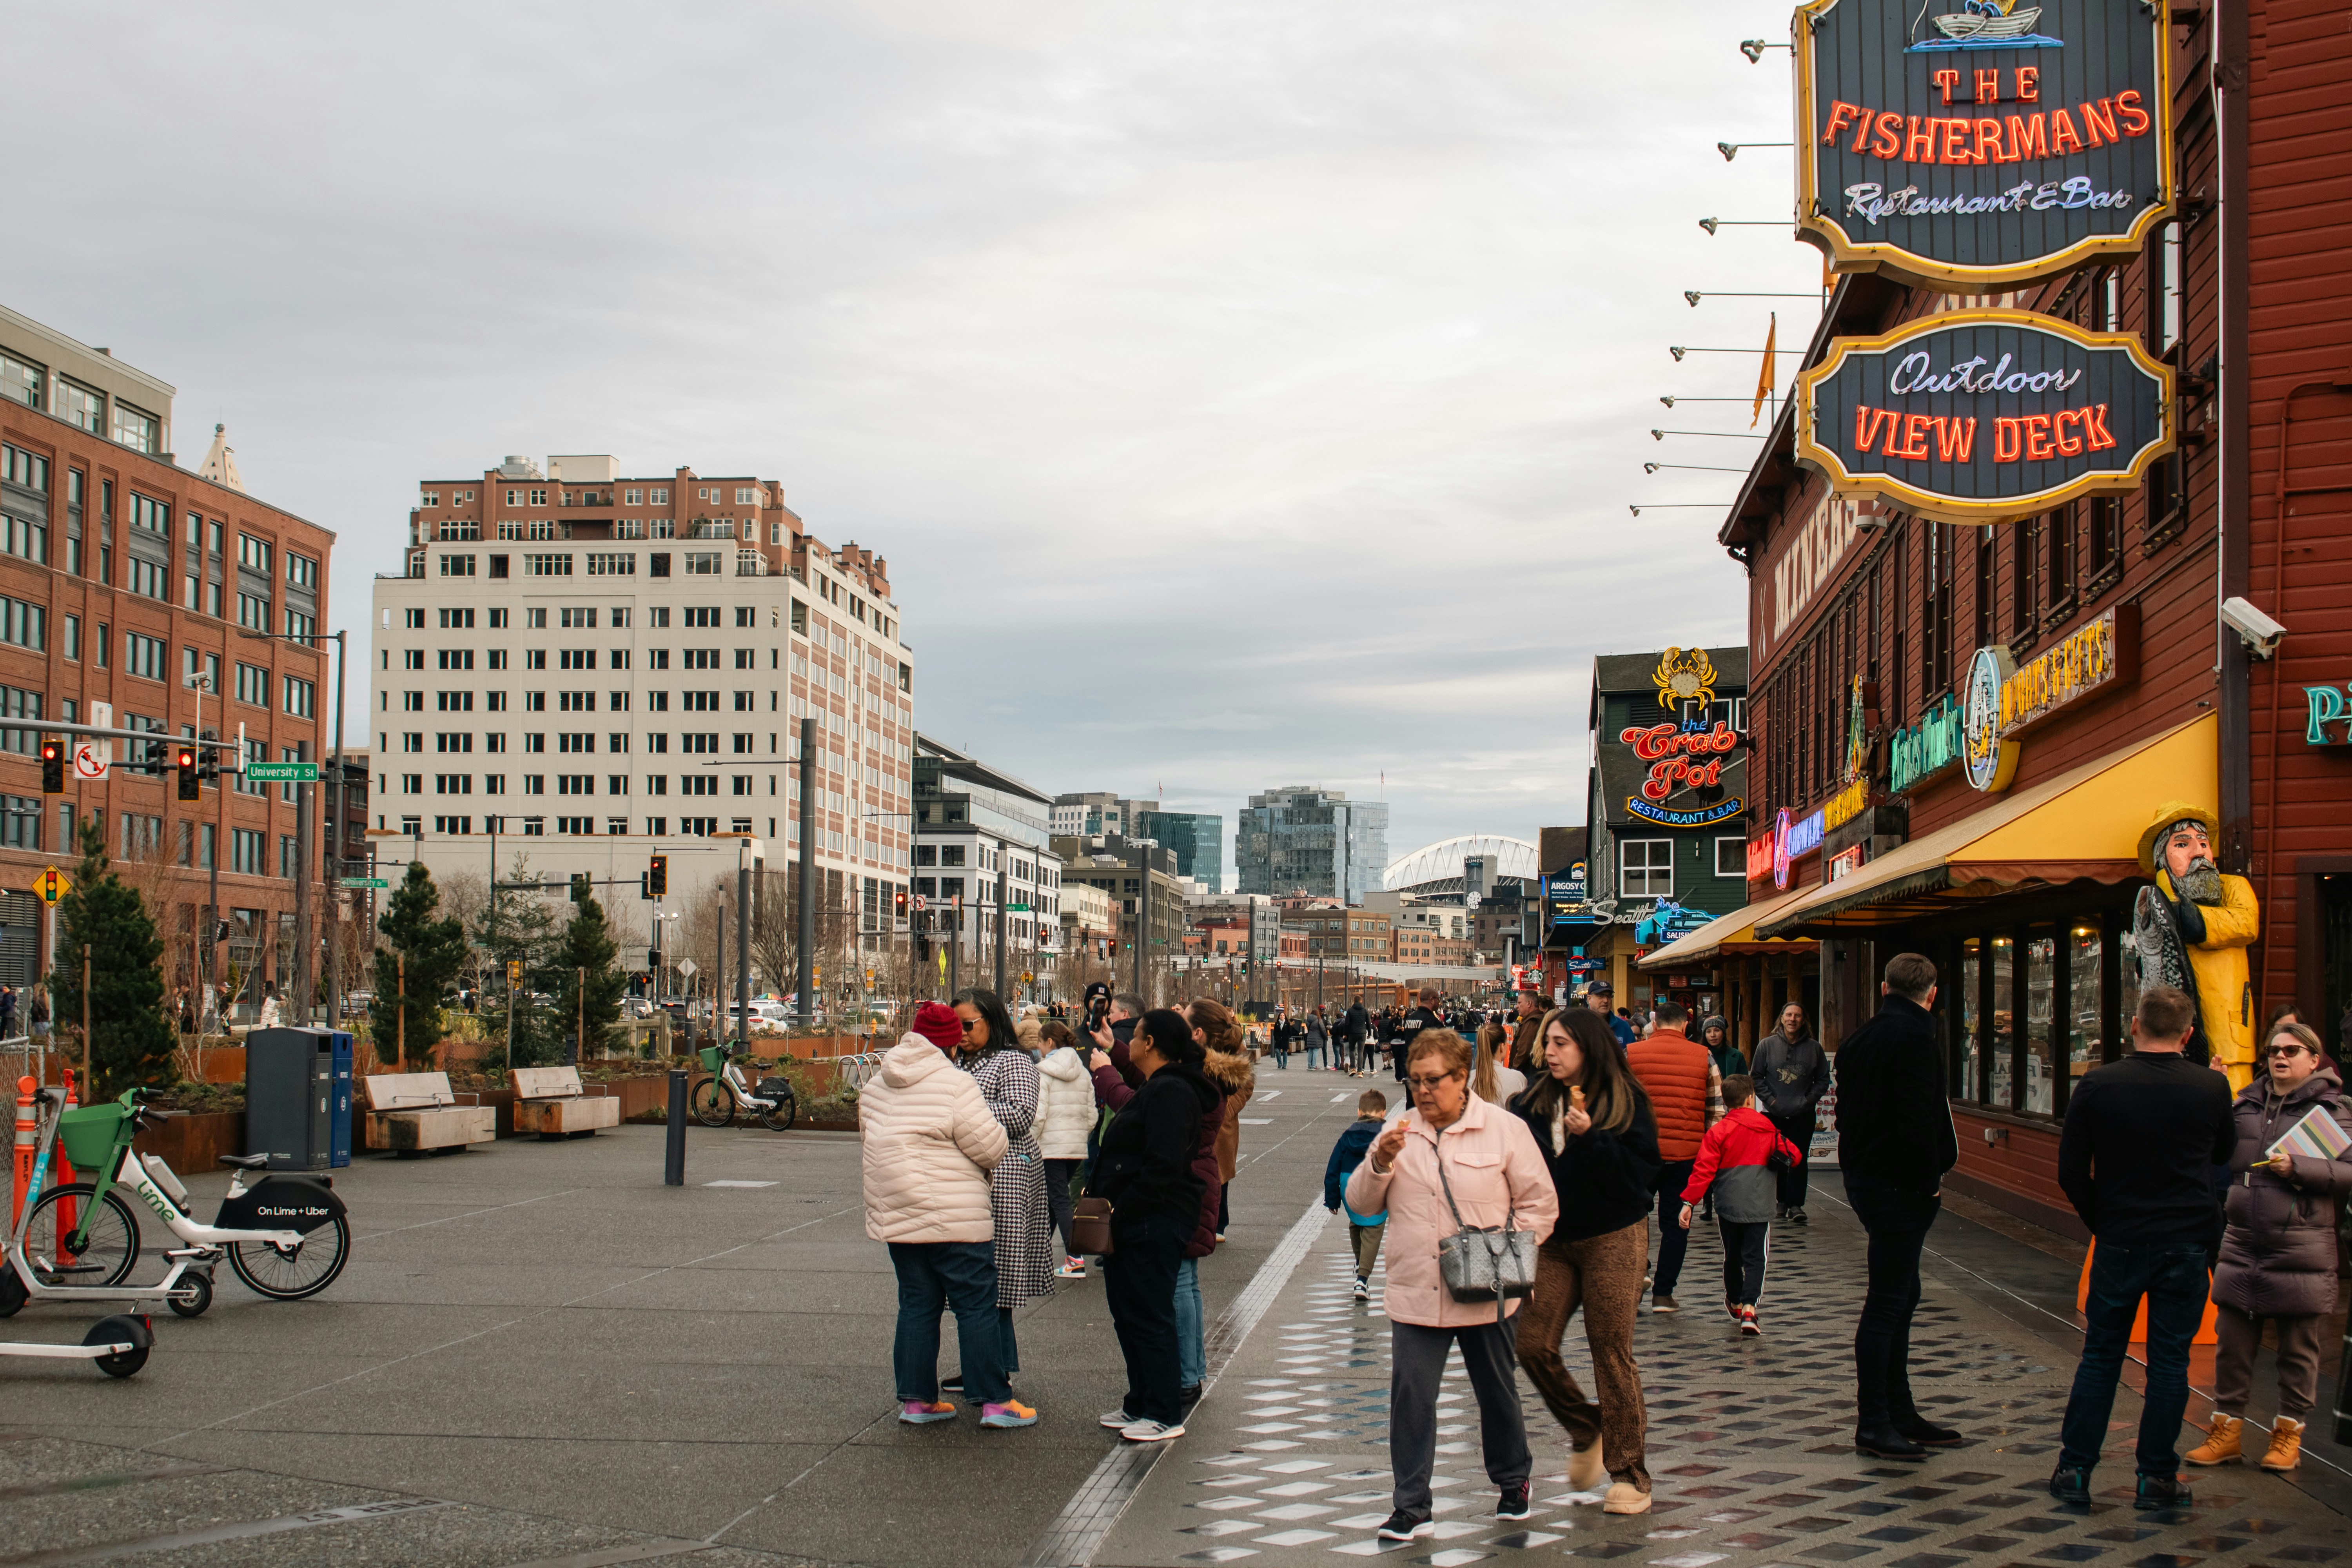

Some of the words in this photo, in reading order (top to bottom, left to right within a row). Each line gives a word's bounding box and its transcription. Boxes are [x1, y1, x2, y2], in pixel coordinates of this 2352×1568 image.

[1933, 66, 2039, 105] THE
[1820, 90, 2151, 165] FISHERMANS
[1844, 179, 2033, 225] Restaurant
[2058, 176, 2133, 210] Bar
[1890, 351, 2082, 395] Outdoor
[1855, 404, 1976, 463] VIEW
[1994, 403, 2116, 463] DECK
[1619, 720, 1737, 760] Crab
[1682, 719, 1707, 731] the
[250, 767, 298, 779] University
[304, 768, 314, 777] St
[1642, 755, 1722, 800] Pot
[1630, 800, 1704, 823] RESTAURANT
[1708, 811, 1719, 820] &
[1717, 800, 1740, 816] BAR
[1592, 900, 1657, 925] Seattle
[1569, 961, 1591, 969] Seattle
[138, 1180, 174, 1223] Lime
[258, 1207, 272, 1215] On
[274, 1207, 297, 1215] Lime
[305, 1207, 329, 1215] Uber
